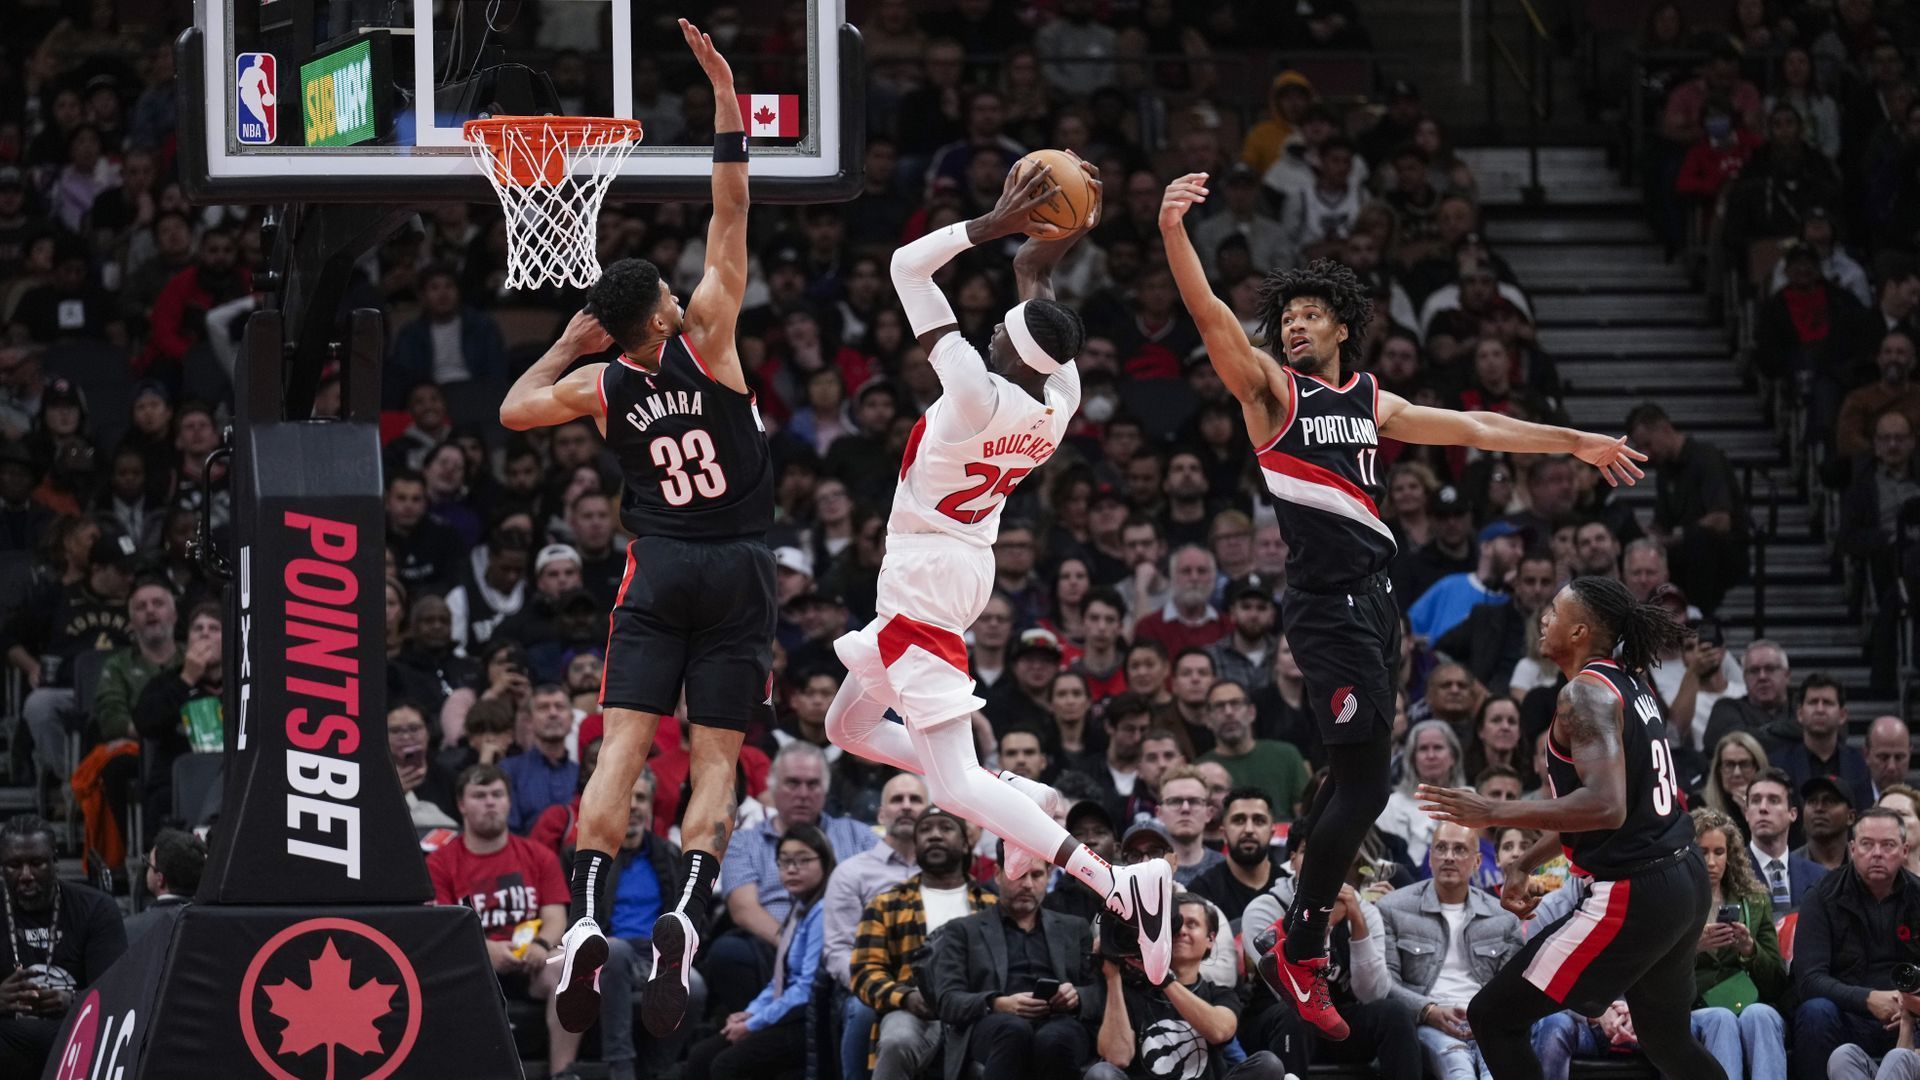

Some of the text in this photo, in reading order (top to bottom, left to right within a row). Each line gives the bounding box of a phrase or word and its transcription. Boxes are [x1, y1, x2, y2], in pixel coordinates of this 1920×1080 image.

[306, 52, 372, 146] SUBWAY
[242, 123, 262, 139] NBA
[625, 390, 702, 432] CAMARA
[1299, 414, 1379, 446] PORTLAND
[649, 428, 728, 506] 33
[983, 433, 1056, 464] BOUCHER
[1356, 448, 1377, 486] 17
[934, 462, 1033, 525] 25
[284, 510, 361, 881] POINTSBET
[493, 886, 538, 910] THE
